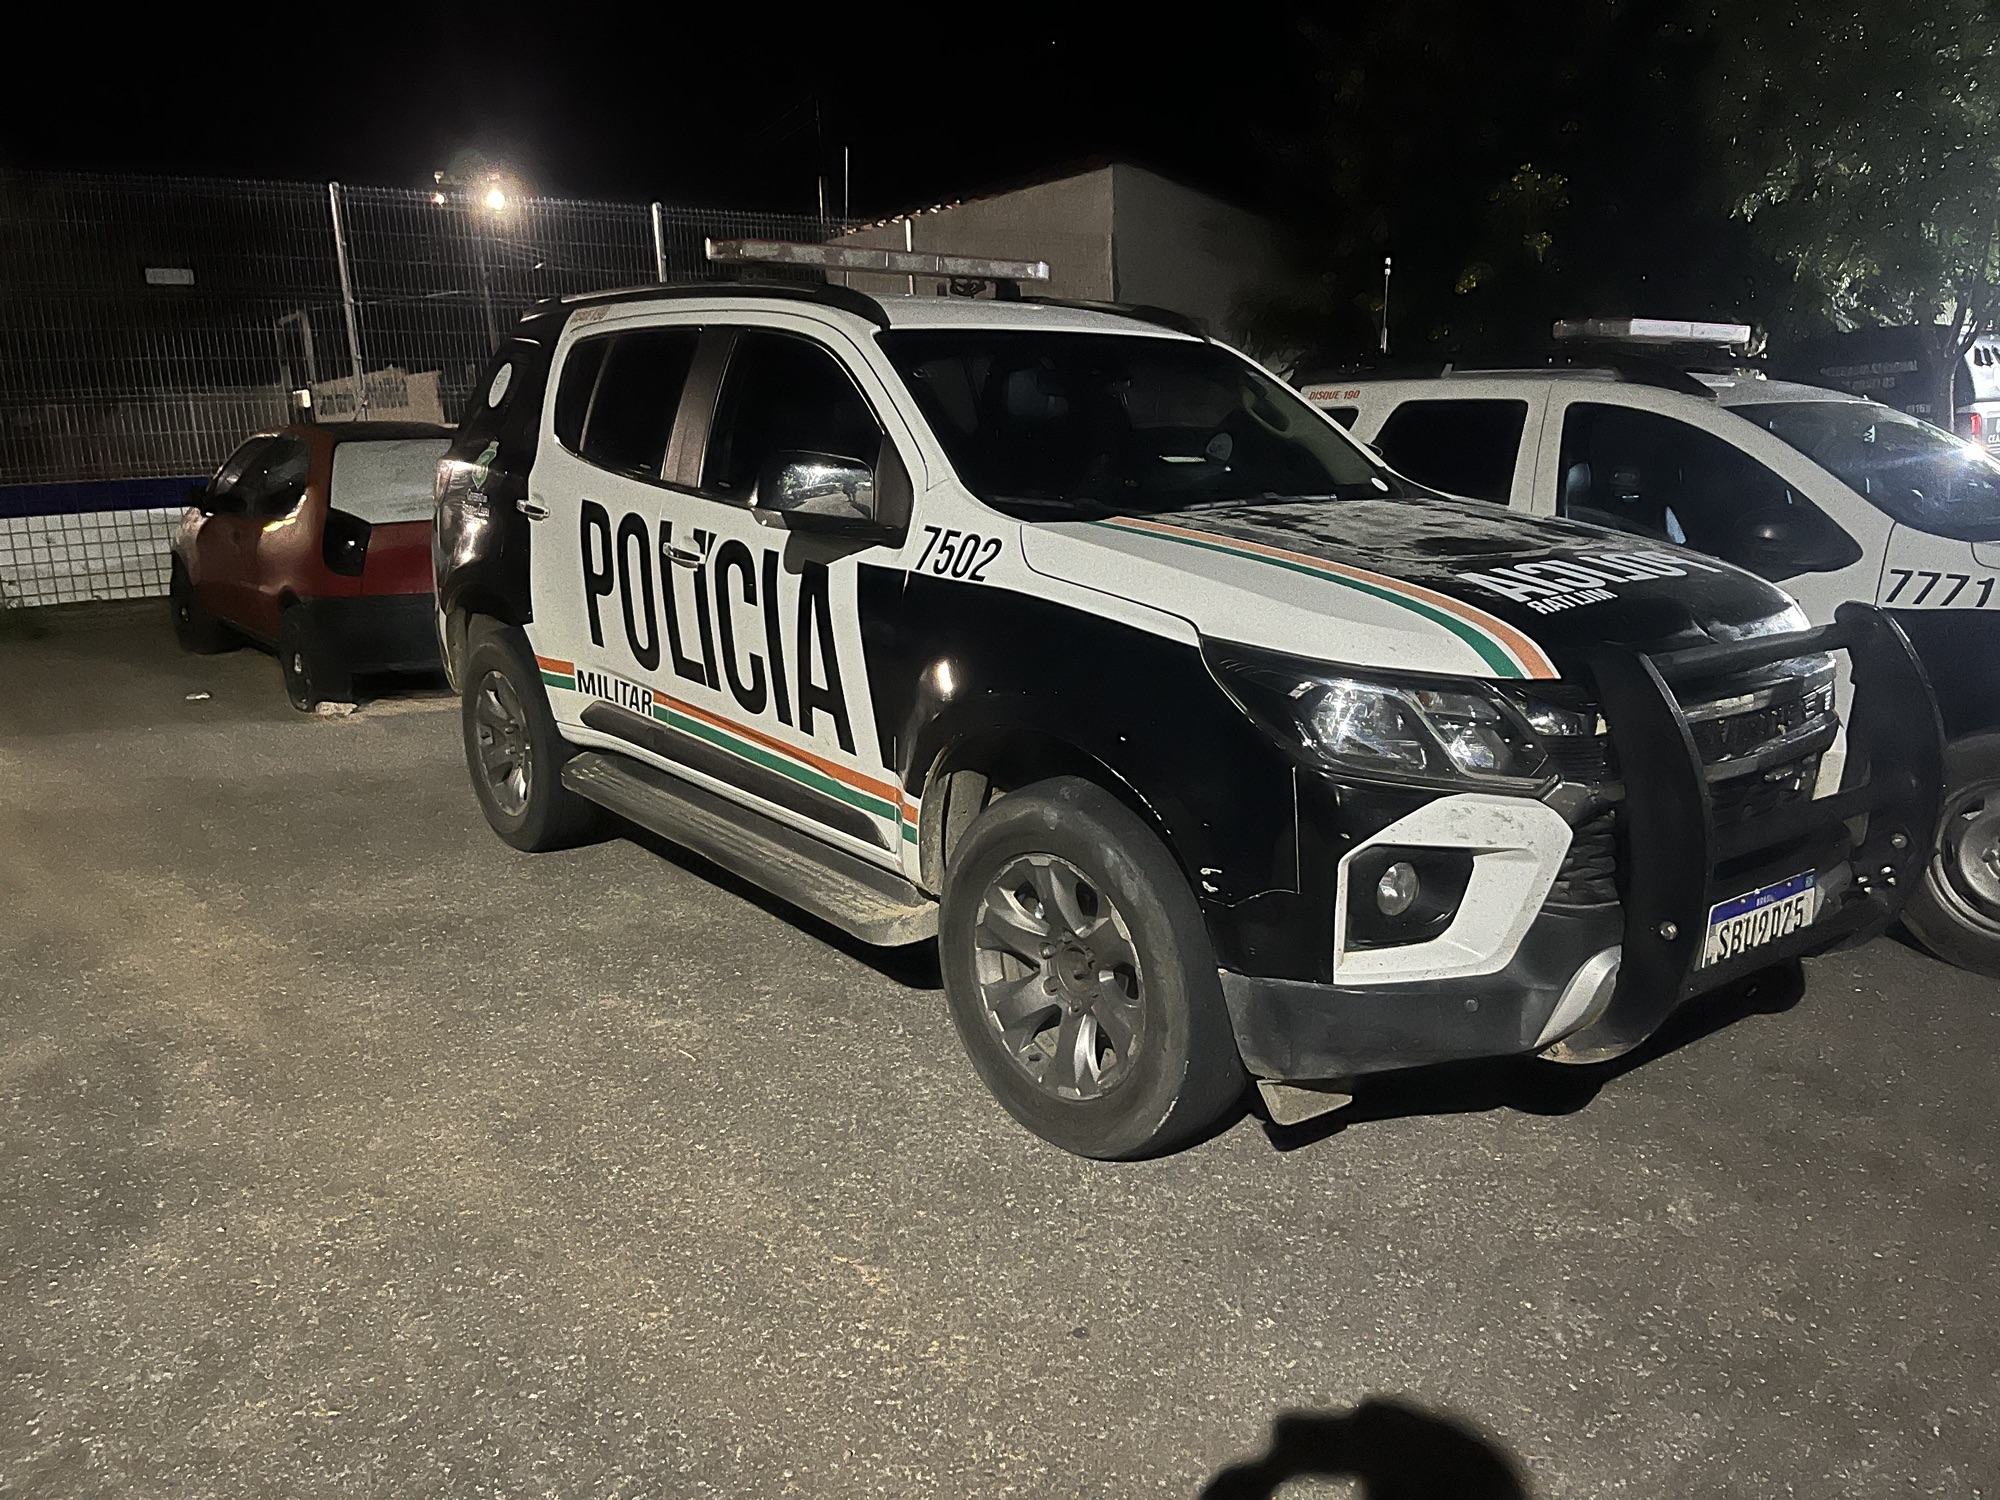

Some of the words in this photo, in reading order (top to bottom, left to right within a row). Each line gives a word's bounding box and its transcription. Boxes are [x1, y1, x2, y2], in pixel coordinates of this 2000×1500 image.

[1308, 391, 1341, 400] DISQUE
[1343, 390, 1361, 400] 190
[914, 525, 1003, 582] 7502
[1885, 568, 1995, 607] 7771
[577, 670, 653, 716] MILITAR
